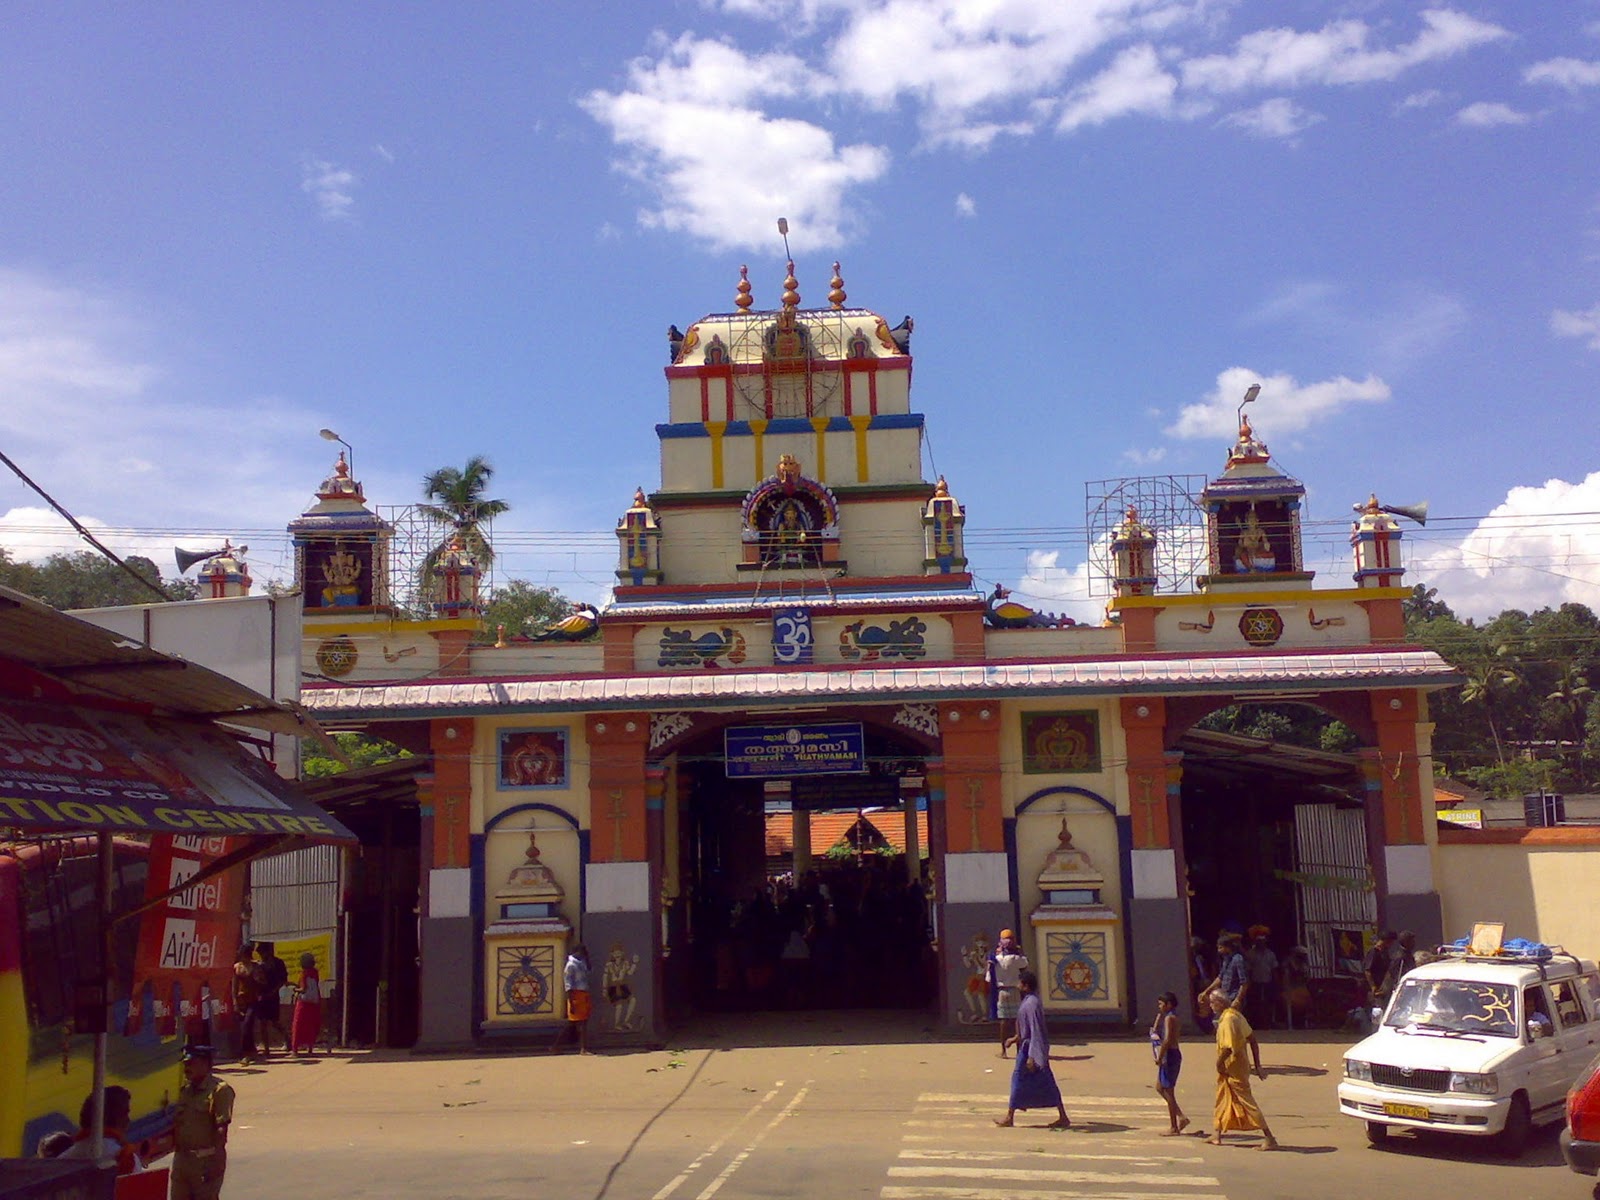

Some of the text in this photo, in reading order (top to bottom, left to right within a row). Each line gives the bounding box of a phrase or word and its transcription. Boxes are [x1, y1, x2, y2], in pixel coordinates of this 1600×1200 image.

[794, 752, 857, 761] THATHVAMASI
[122, 789, 170, 800] CD
[0, 797, 335, 835] TION CENTRE
[169, 871, 222, 910] Airtel
[162, 931, 217, 968] Airtel
